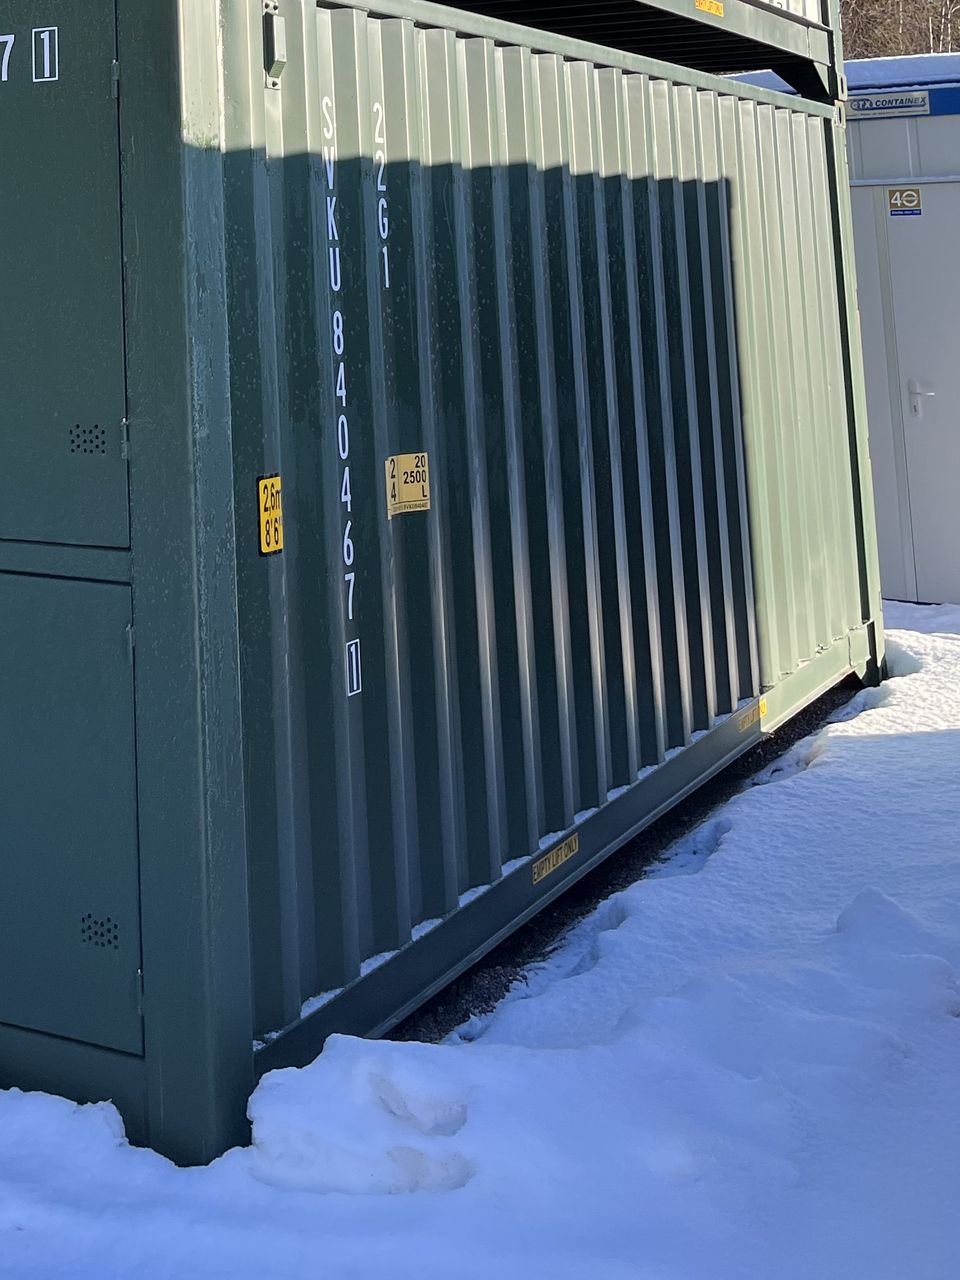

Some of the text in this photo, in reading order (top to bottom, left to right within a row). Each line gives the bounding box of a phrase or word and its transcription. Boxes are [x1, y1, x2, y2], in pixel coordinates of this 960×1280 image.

[38, 30, 53, 79] 1
[373, 102, 390, 288] 22G1
[322, 96, 359, 692] SVKU 840467 1
[390, 457, 396, 479] 2
[414, 455, 426, 469] 20
[403, 469, 427, 485] 2500
[422, 484, 428, 498] L
